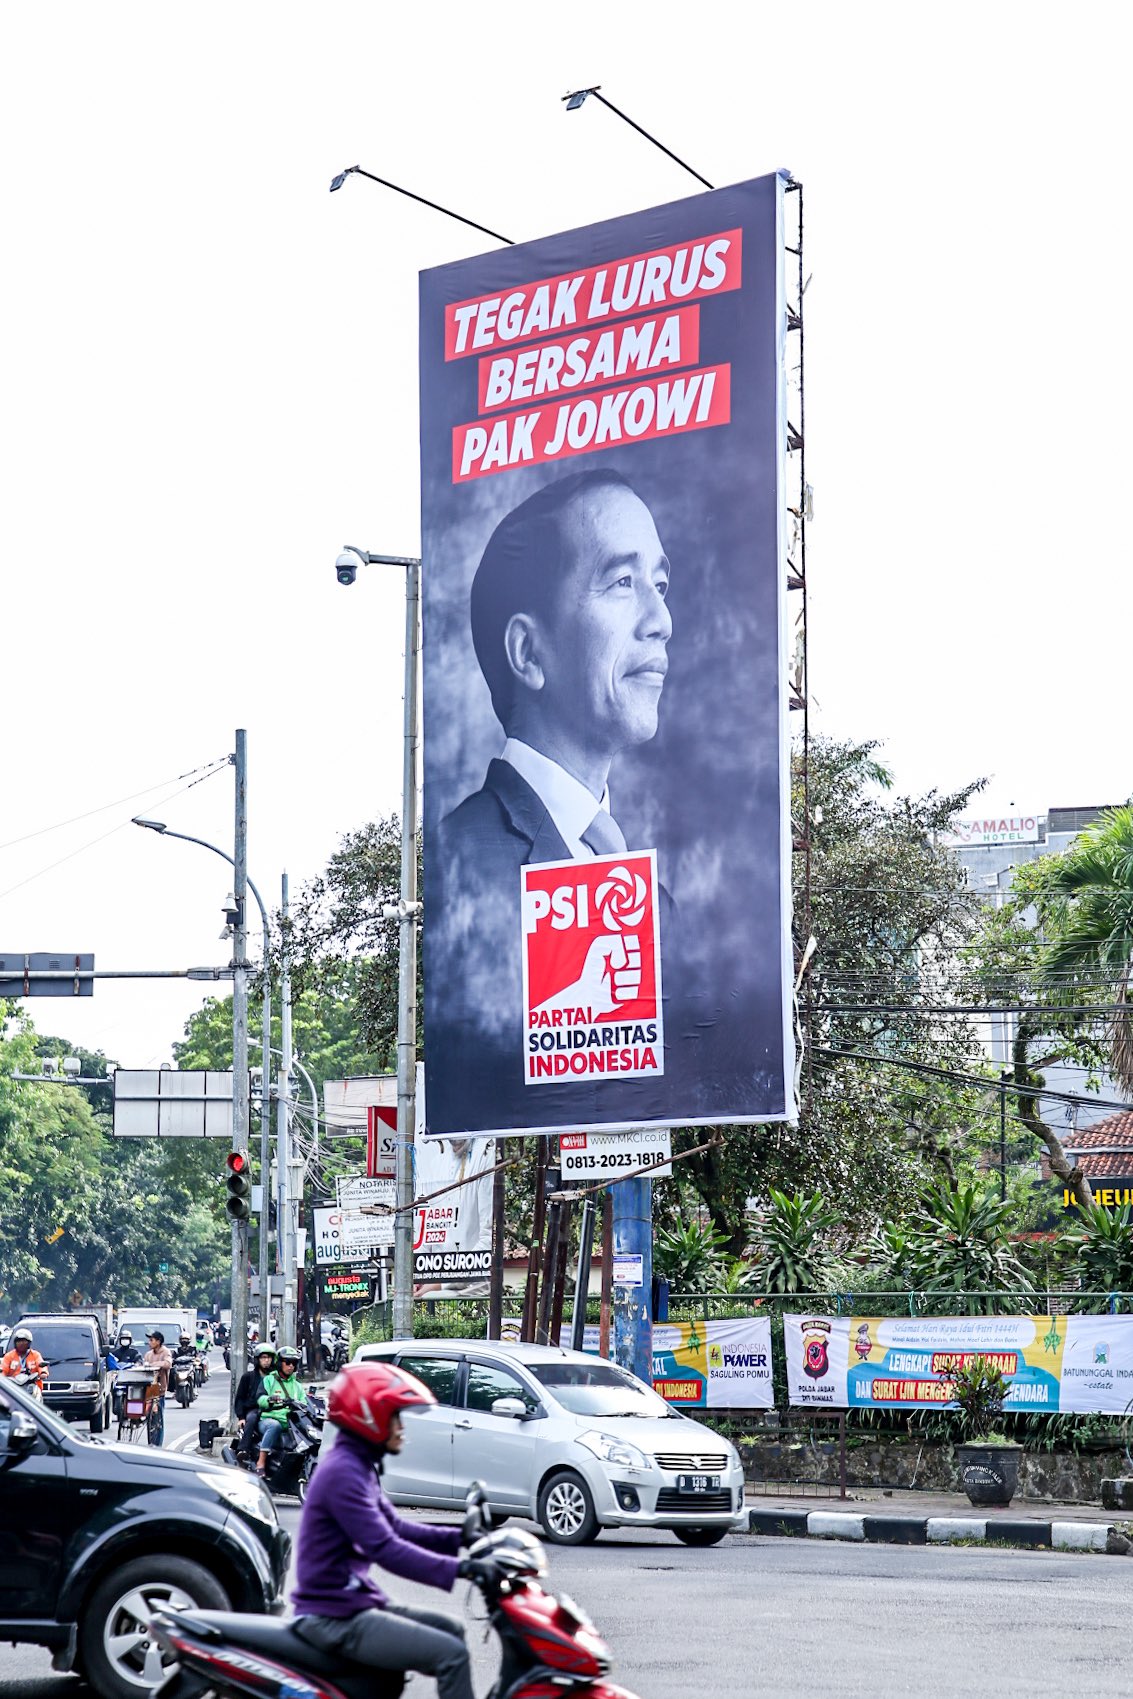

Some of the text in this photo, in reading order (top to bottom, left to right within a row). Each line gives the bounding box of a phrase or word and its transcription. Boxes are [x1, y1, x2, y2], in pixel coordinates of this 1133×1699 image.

[454, 240, 731, 353] TEGAK LURUS
[485, 314, 681, 408] BERSAMA
[460, 371, 716, 476] PAK JOKOWI
[971, 818, 1036, 834] AMALIO
[984, 832, 1024, 842] HOTEL
[526, 883, 590, 934] PSI
[529, 1007, 592, 1029] PARTAI
[529, 1023, 658, 1052] SOLIDARITAS
[530, 1047, 658, 1078] INDONESIA
[566, 1152, 665, 1169] 0813-2023-1818
[360, 1180, 397, 1189] NOTARIS
[427, 1232, 446, 1242] 2024
[416, 1252, 492, 1271] ONO SURONO
[327, 1276, 361, 1284] augusta
[722, 1343, 767, 1354] INDONESIA
[724, 1354, 767, 1367] POWER
[889, 1353, 931, 1372] LENGKAPI
[710, 1370, 770, 1379] SAGULING POMU
[1063, 1368, 1114, 1378] BATUNUNGGAL
[664, 1383, 698, 1398] INDONESIA
[856, 1381, 871, 1398] DAN
[873, 1381, 898, 1400] SURAT
